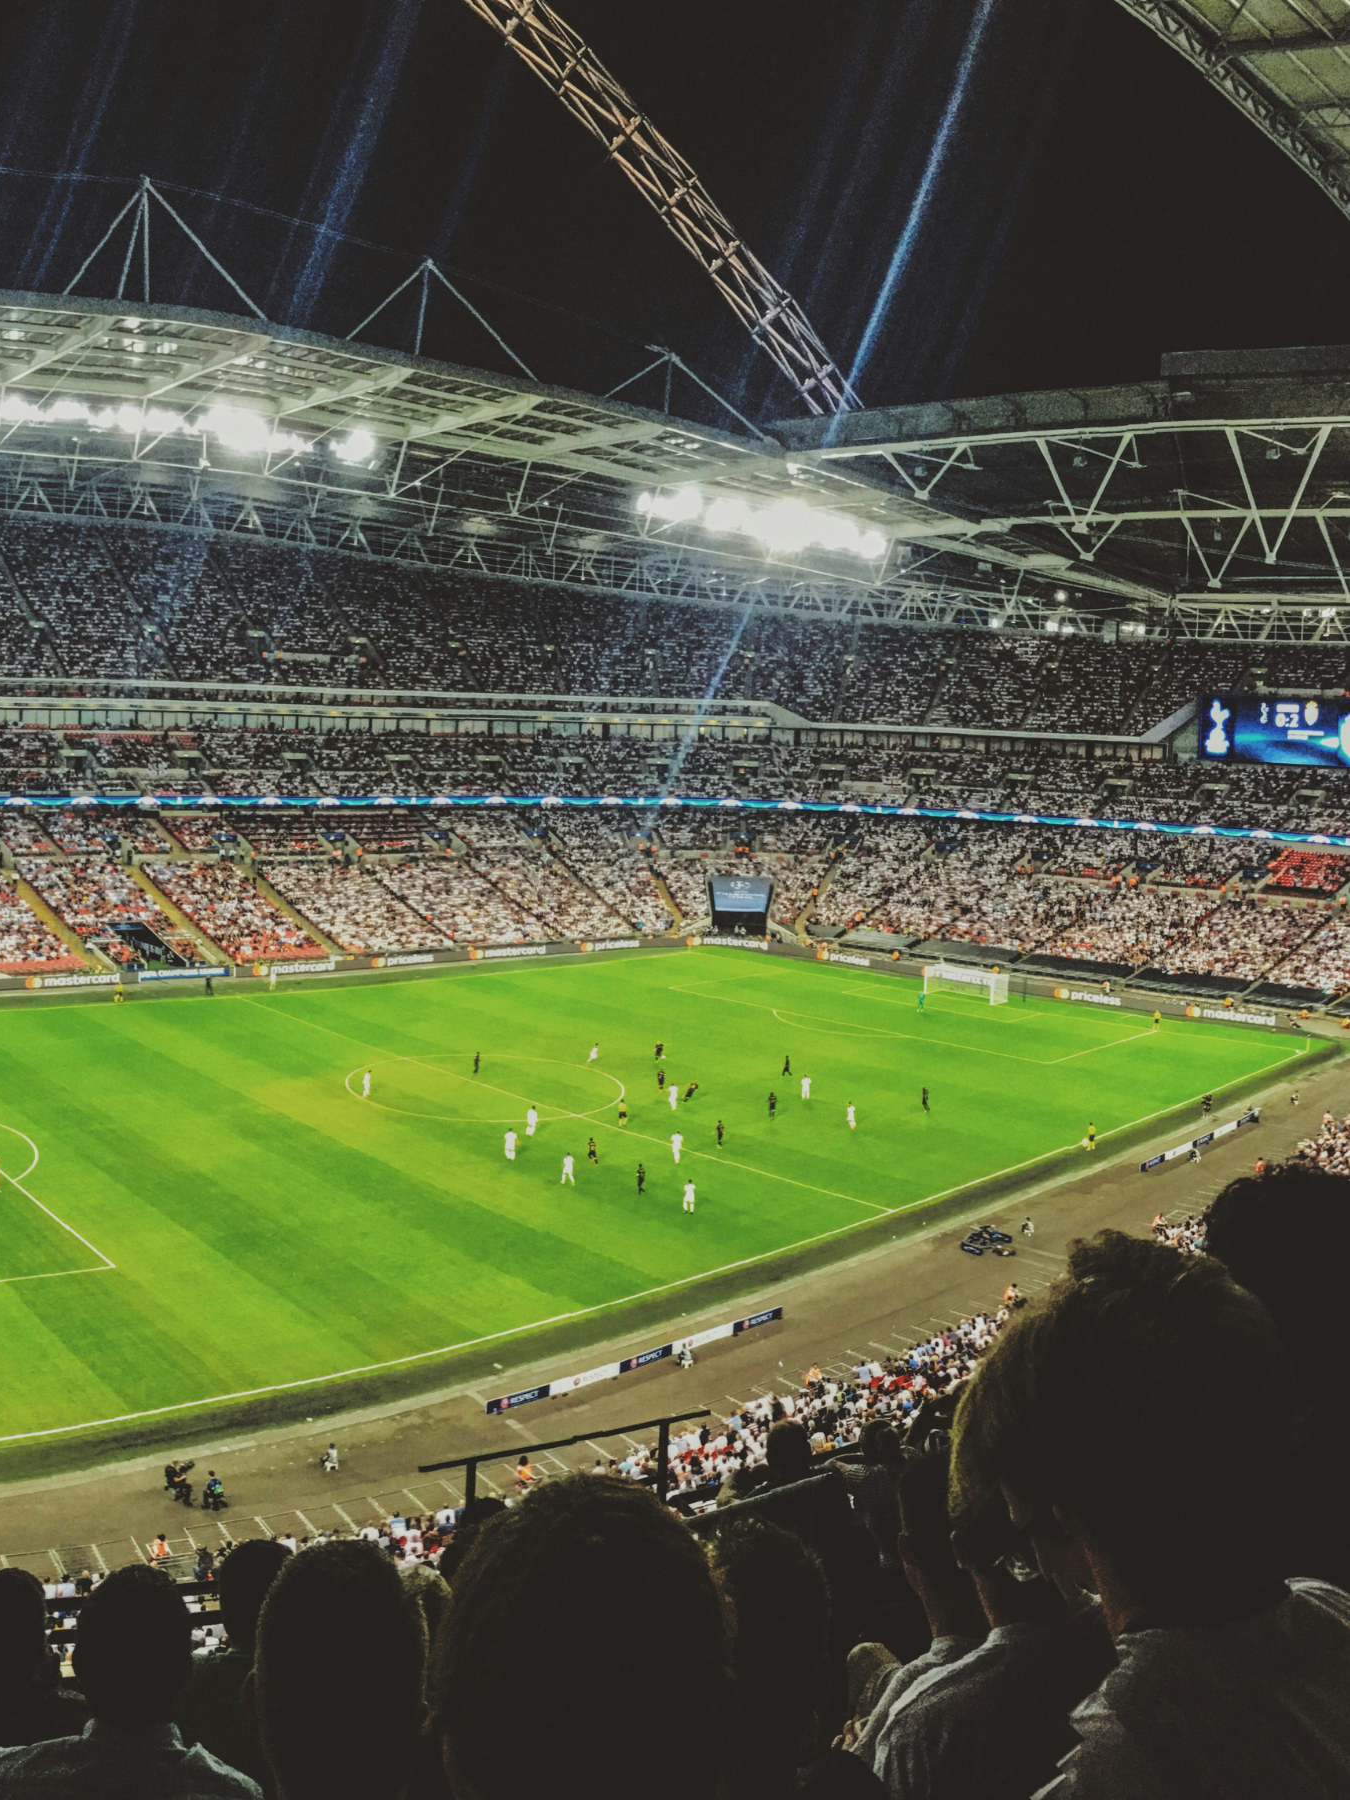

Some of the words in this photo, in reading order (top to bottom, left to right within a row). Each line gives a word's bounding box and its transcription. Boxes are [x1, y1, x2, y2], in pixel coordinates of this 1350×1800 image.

[1275, 713, 1299, 727] 0:2
[594, 939, 640, 952] priceless
[703, 937, 768, 950] mastercard
[484, 945, 546, 957] mastercard
[270, 960, 335, 974] mastercard
[387, 954, 434, 966] priceless
[830, 953, 870, 967] priceless
[44, 973, 120, 987] mastercard
[1071, 991, 1121, 1006] priceless
[1203, 1009, 1275, 1026] mastercard
[750, 1312, 774, 1325] RESPECT
[638, 1350, 663, 1364] RESPECT
[582, 1369, 607, 1382] RESPECT
[510, 1390, 539, 1404] RESPECT
